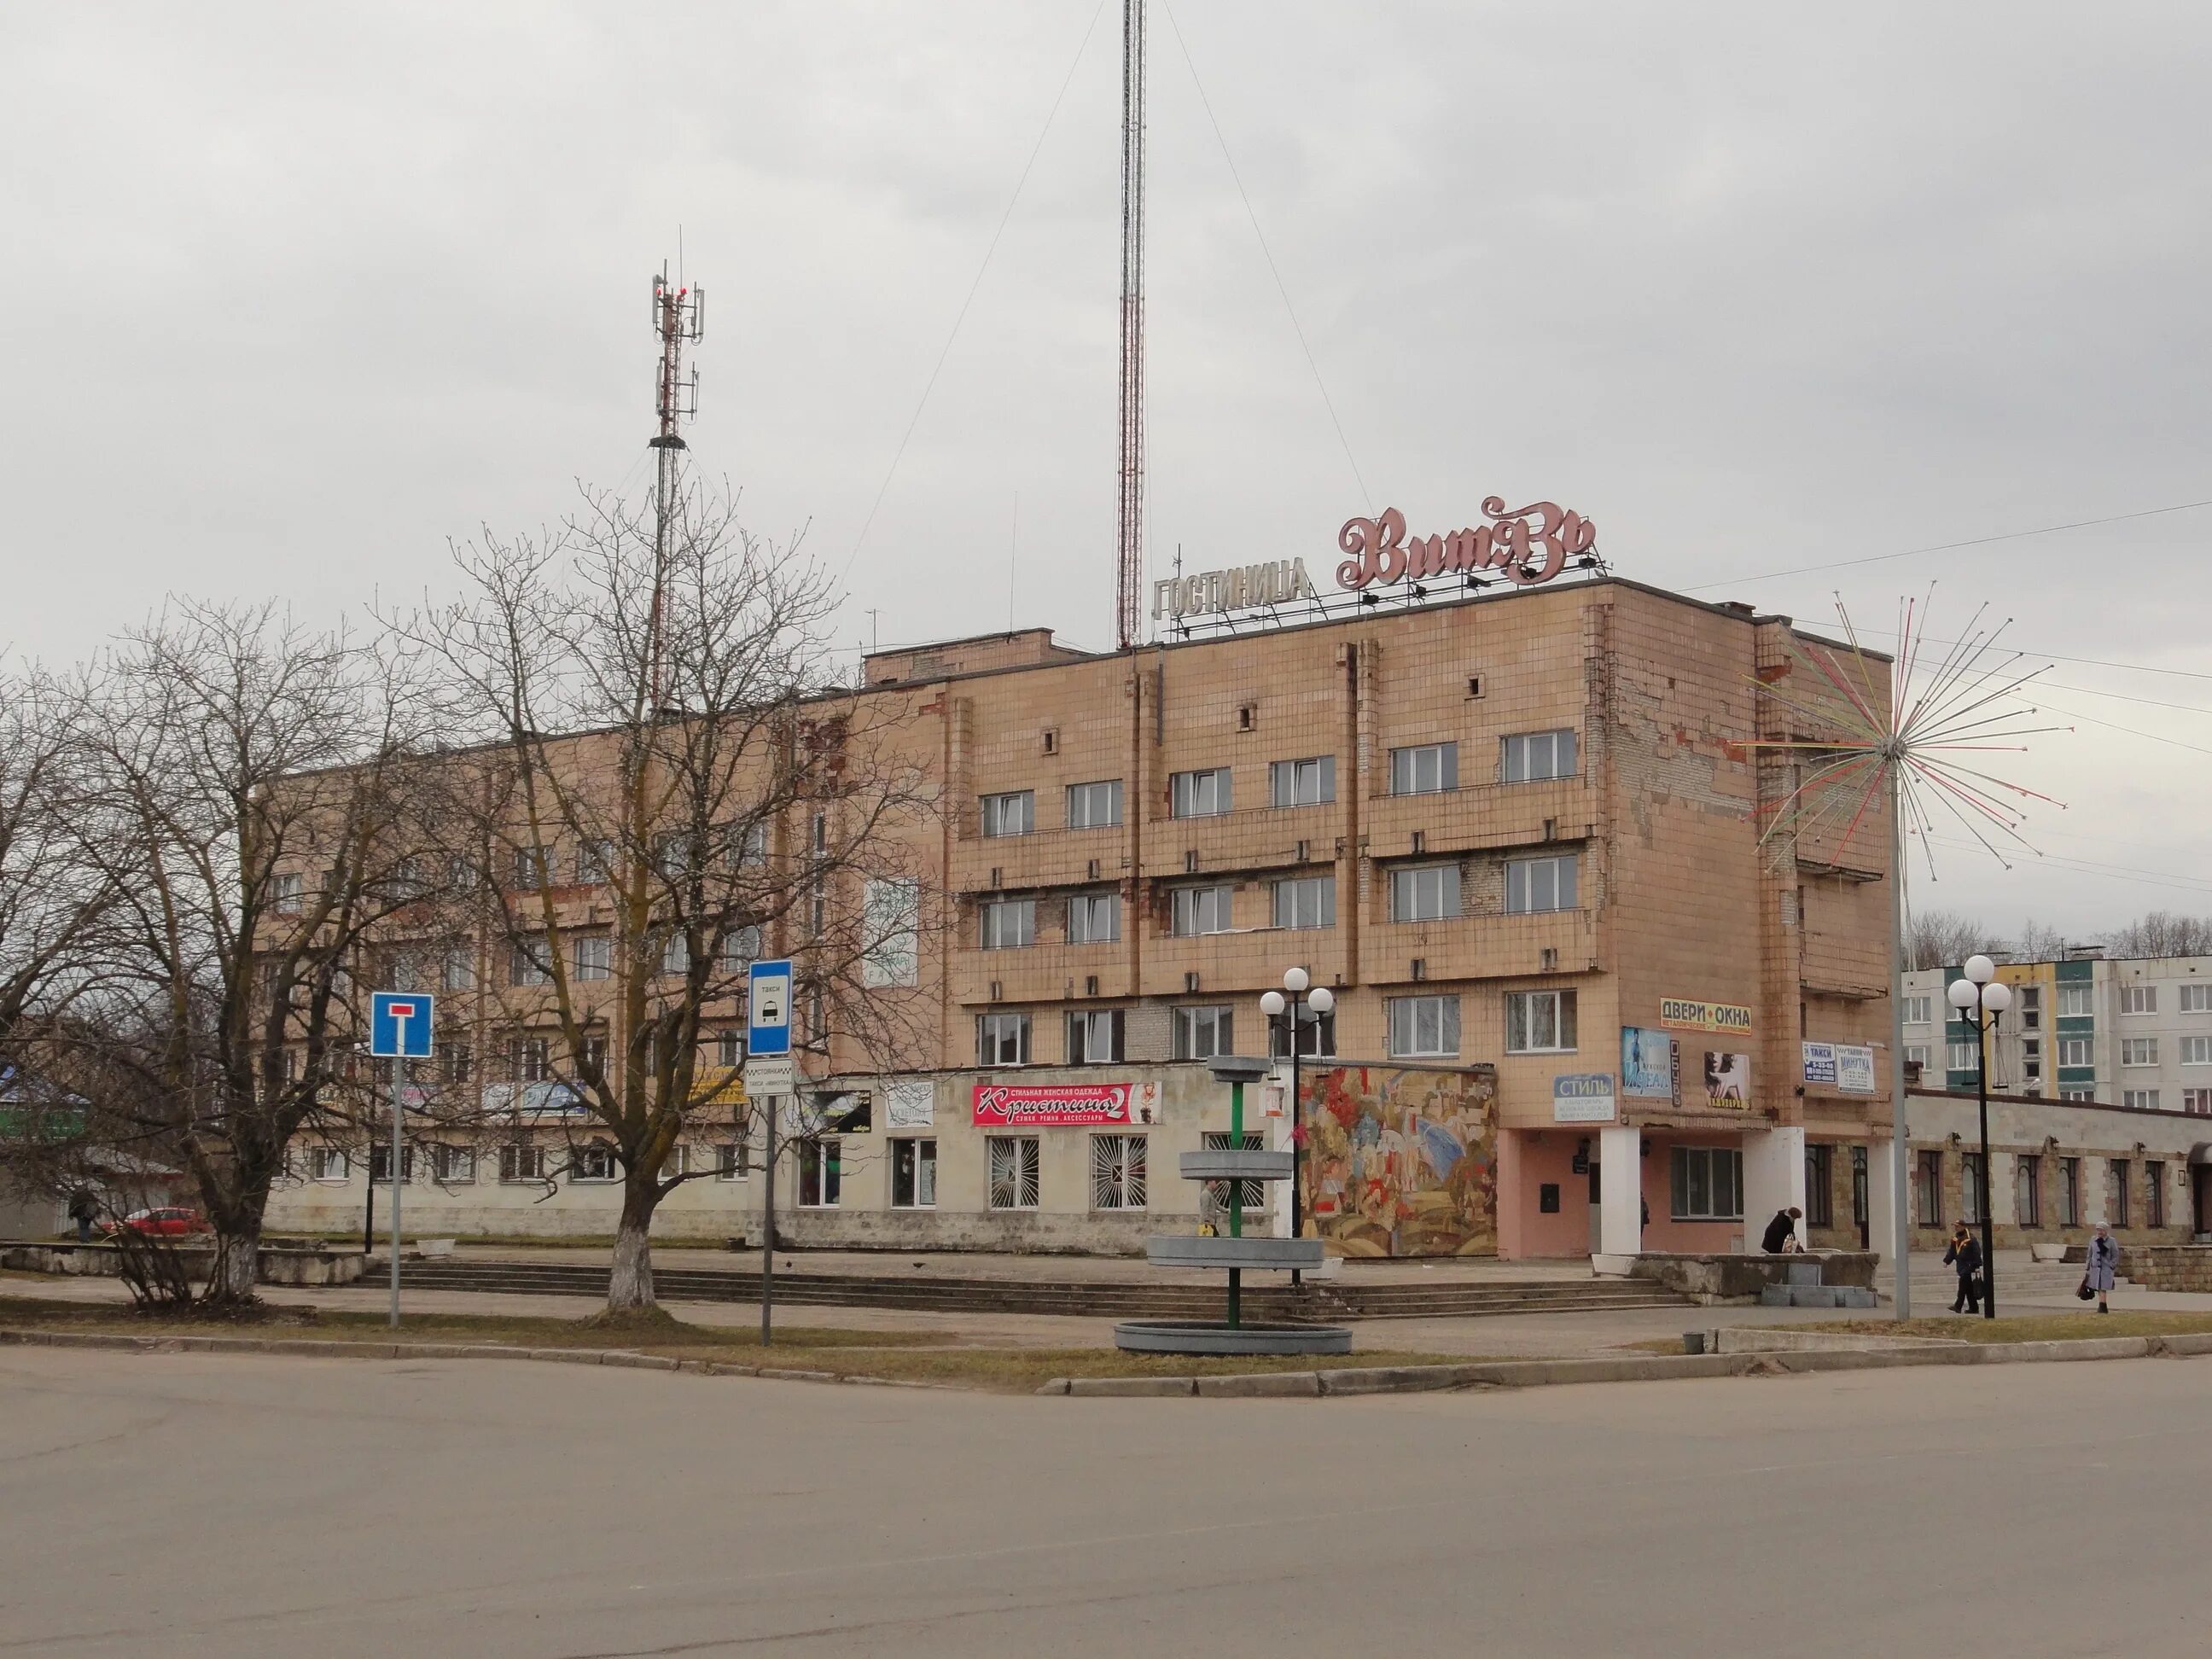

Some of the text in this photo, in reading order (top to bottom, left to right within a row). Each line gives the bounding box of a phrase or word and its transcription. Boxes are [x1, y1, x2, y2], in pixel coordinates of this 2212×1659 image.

[1153, 556, 1309, 620] ГОСТИНИЦА
[1662, 1000, 1750, 1027] ДВЕРИ ОКНА
[1810, 1048, 1832, 1059] ТАКСИ
[1840, 1056, 1871, 1074] МИНУТКА
[1559, 1080, 1610, 1096] СТИЛЬ
[977, 1087, 1125, 1124] Кристина 2
